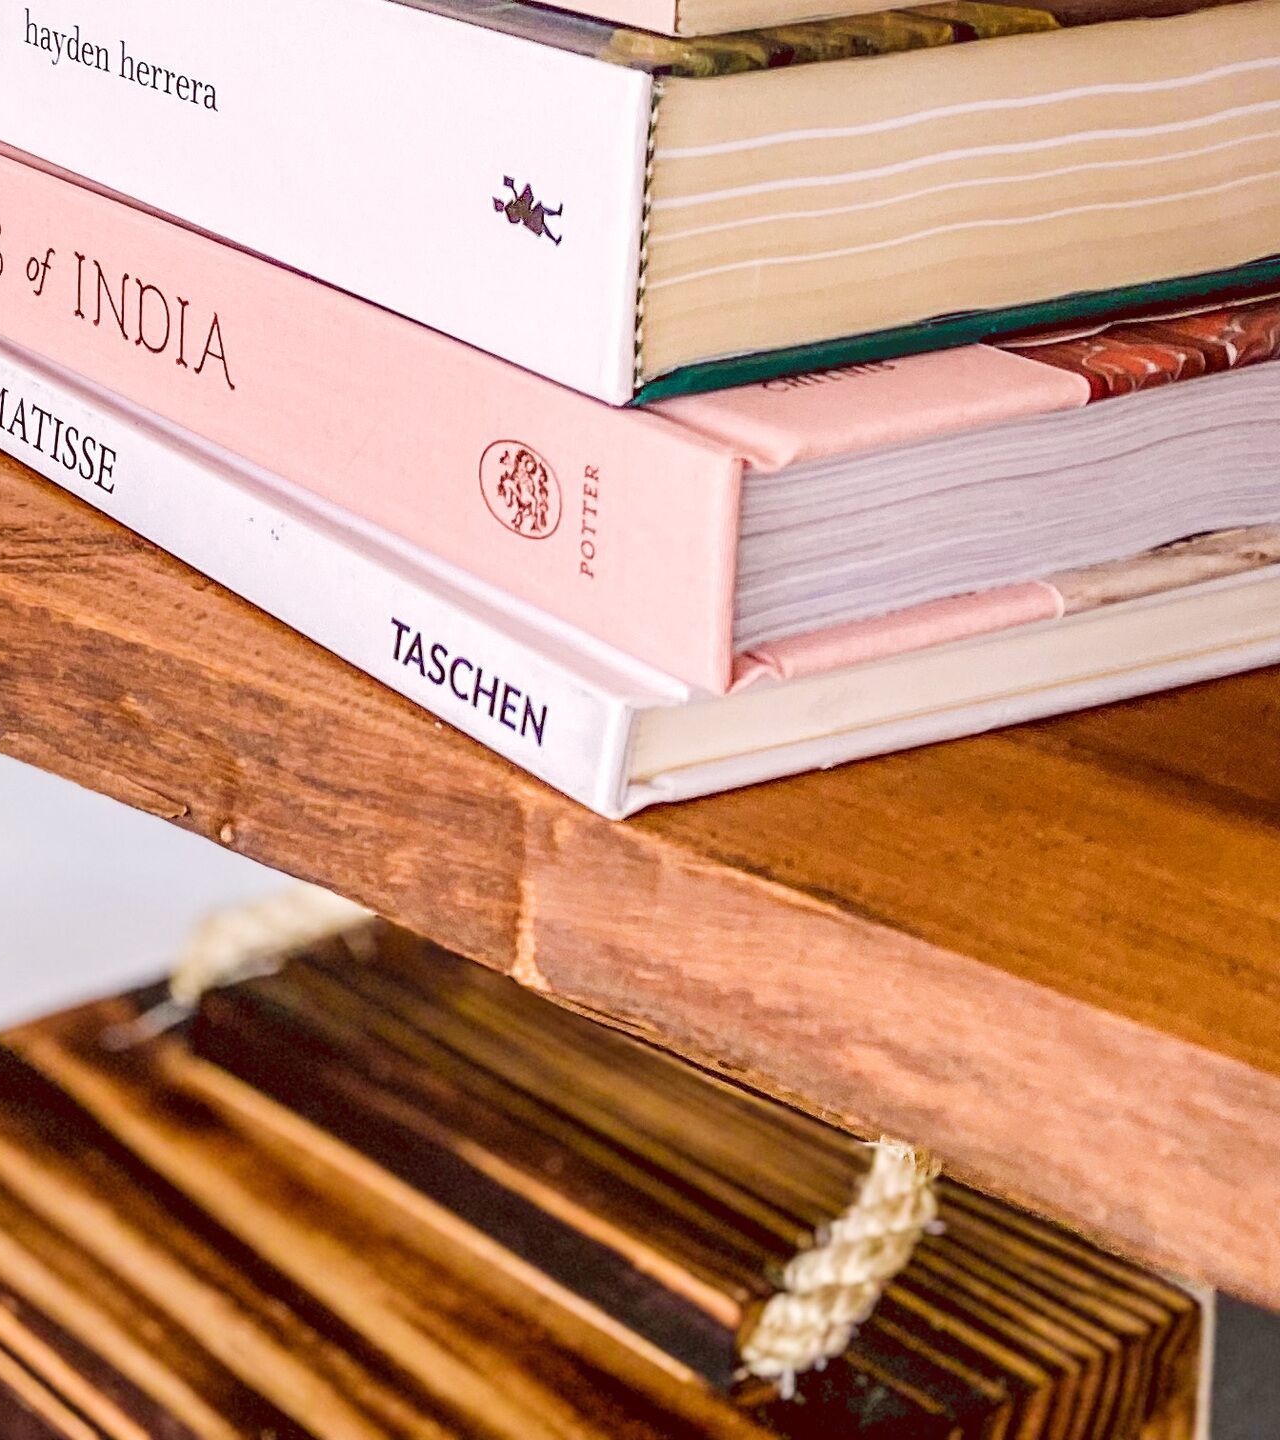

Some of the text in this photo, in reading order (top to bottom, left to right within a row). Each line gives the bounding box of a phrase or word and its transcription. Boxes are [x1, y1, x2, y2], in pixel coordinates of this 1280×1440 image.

[24, 8, 110, 73] hayden
[118, 41, 220, 113] herrera
[25, 248, 56, 296] of
[73, 251, 236, 391] INDIA
[578, 463, 601, 580] POTTER
[390, 616, 548, 747] TASCHEN
